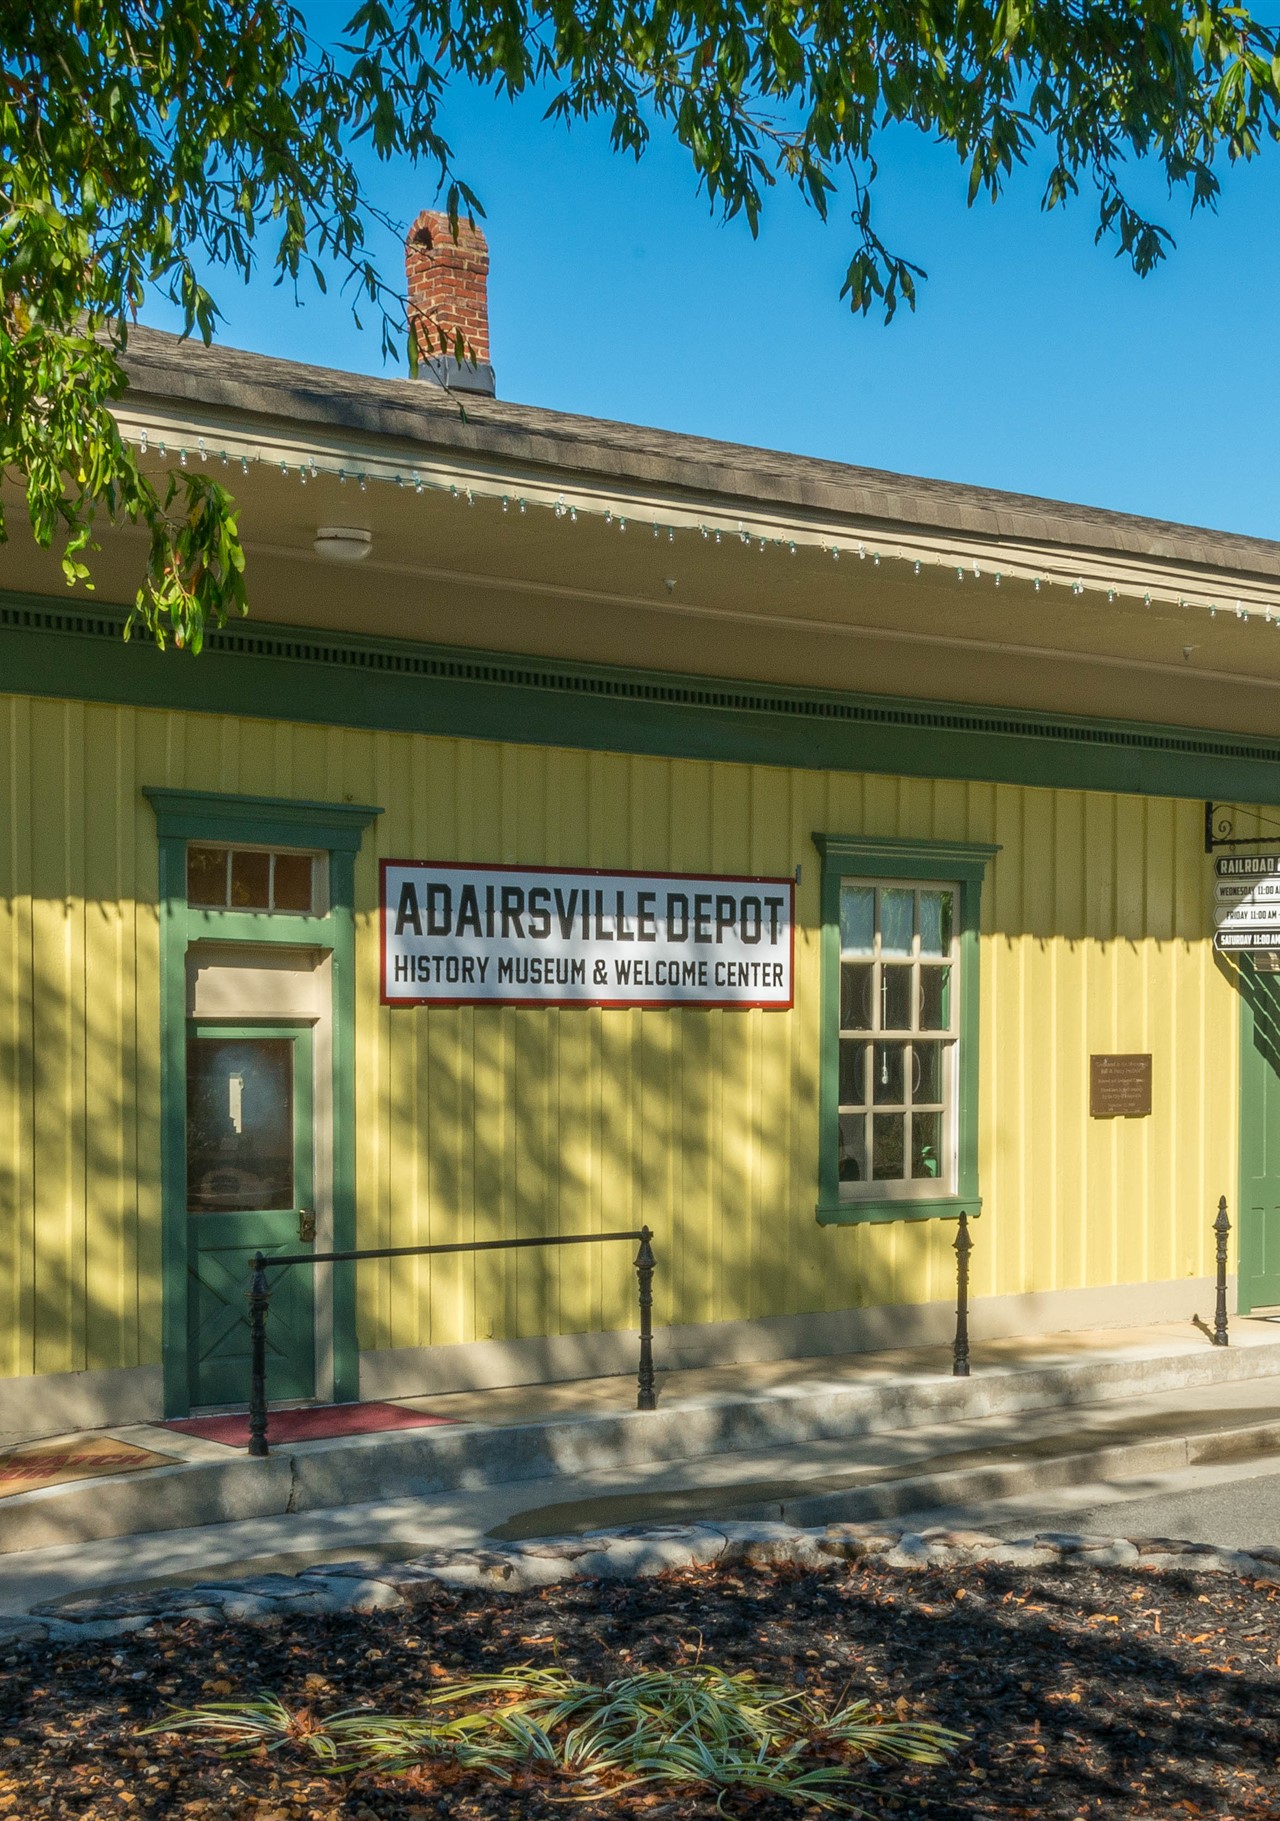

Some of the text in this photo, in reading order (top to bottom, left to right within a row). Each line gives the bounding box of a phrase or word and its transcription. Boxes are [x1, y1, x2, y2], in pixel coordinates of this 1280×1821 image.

[1220, 858, 1274, 874] RAILROAD
[1220, 886, 1255, 896] WEDNESDAY
[1257, 885, 1274, 895] 11:00
[394, 881, 785, 945] ADAIRSVILLE DEPOT
[1226, 910, 1248, 920] FRIDAY
[1250, 910, 1267, 920] 11:00
[1268, 910, 1277, 919] AM
[1221, 934, 1252, 945] SATURDAY
[1253, 934, 1270, 945] 11:00
[1271, 934, 1280, 945] AM
[394, 954, 784, 988] HISTORY MUSEUM & WELCOME CENTER
[6, 1454, 151, 1468] WATCH
